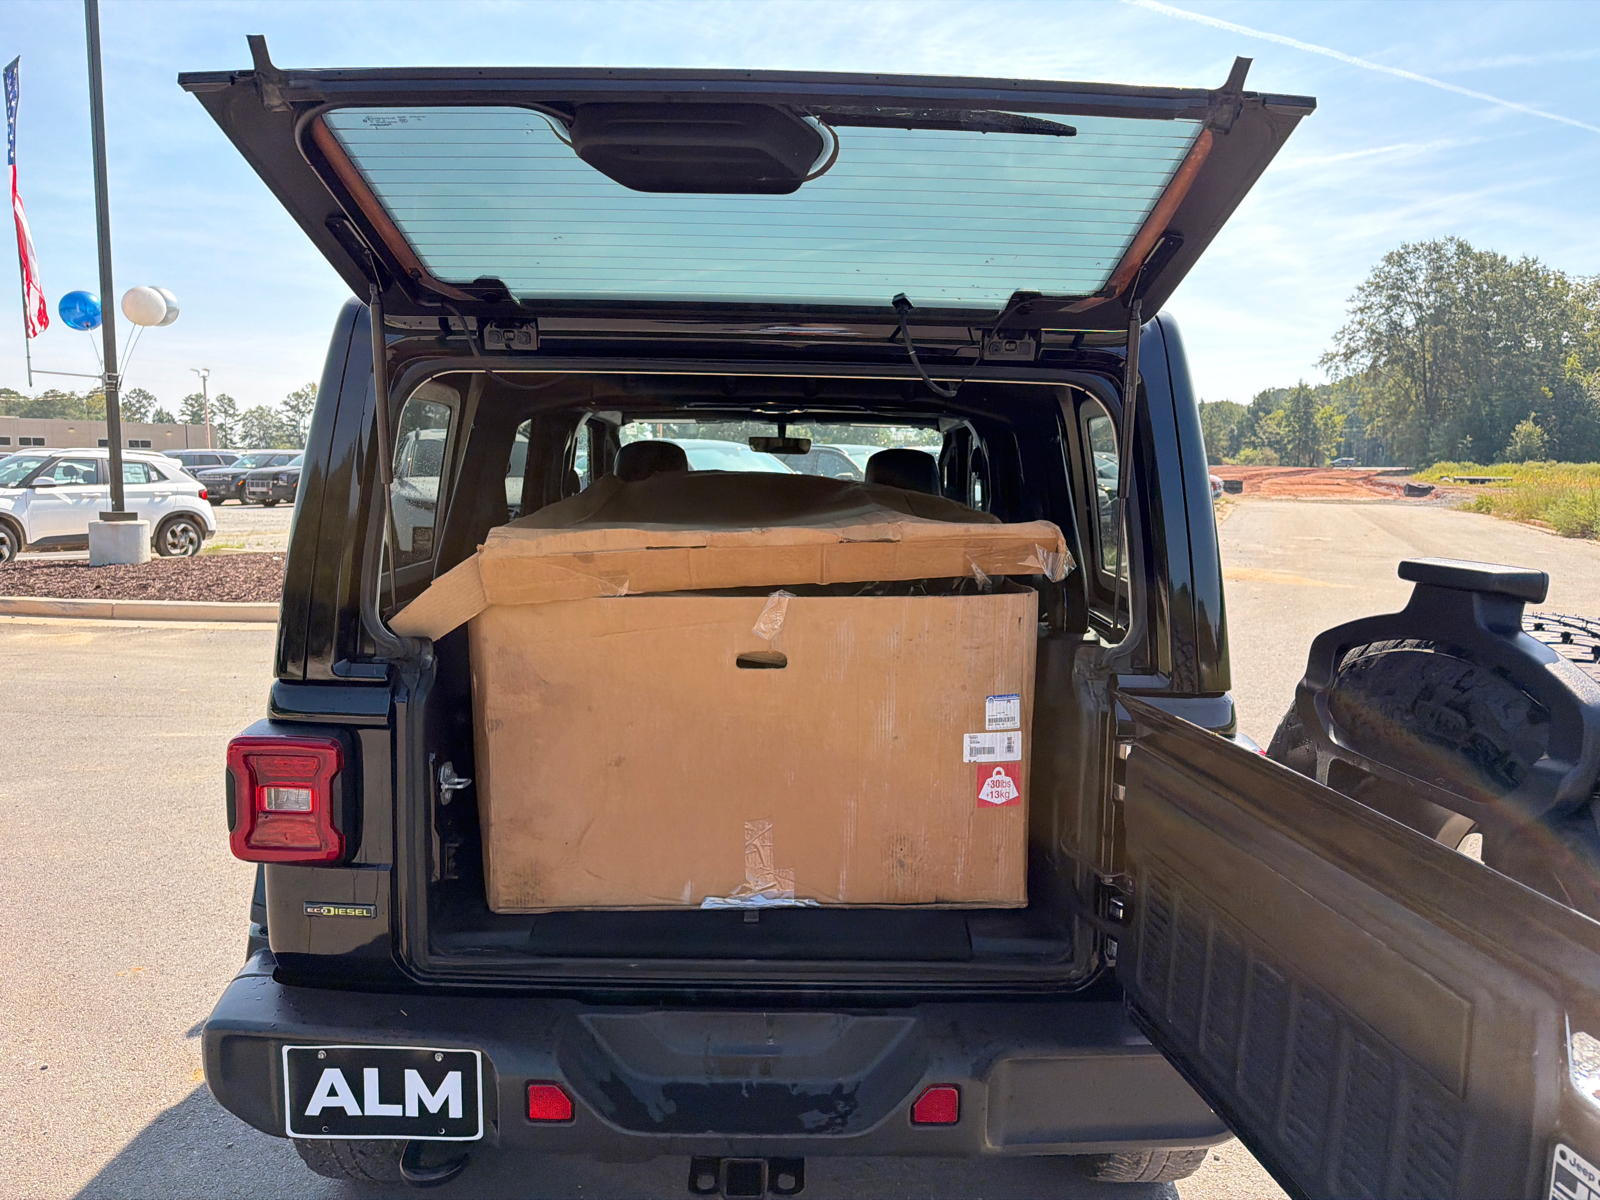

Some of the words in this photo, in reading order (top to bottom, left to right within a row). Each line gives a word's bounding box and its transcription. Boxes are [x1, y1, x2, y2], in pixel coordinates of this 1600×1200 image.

[986, 790, 1010, 800] +13kg
[304, 1067, 463, 1118] ALM
[1569, 1157, 1595, 1181] Jeep
